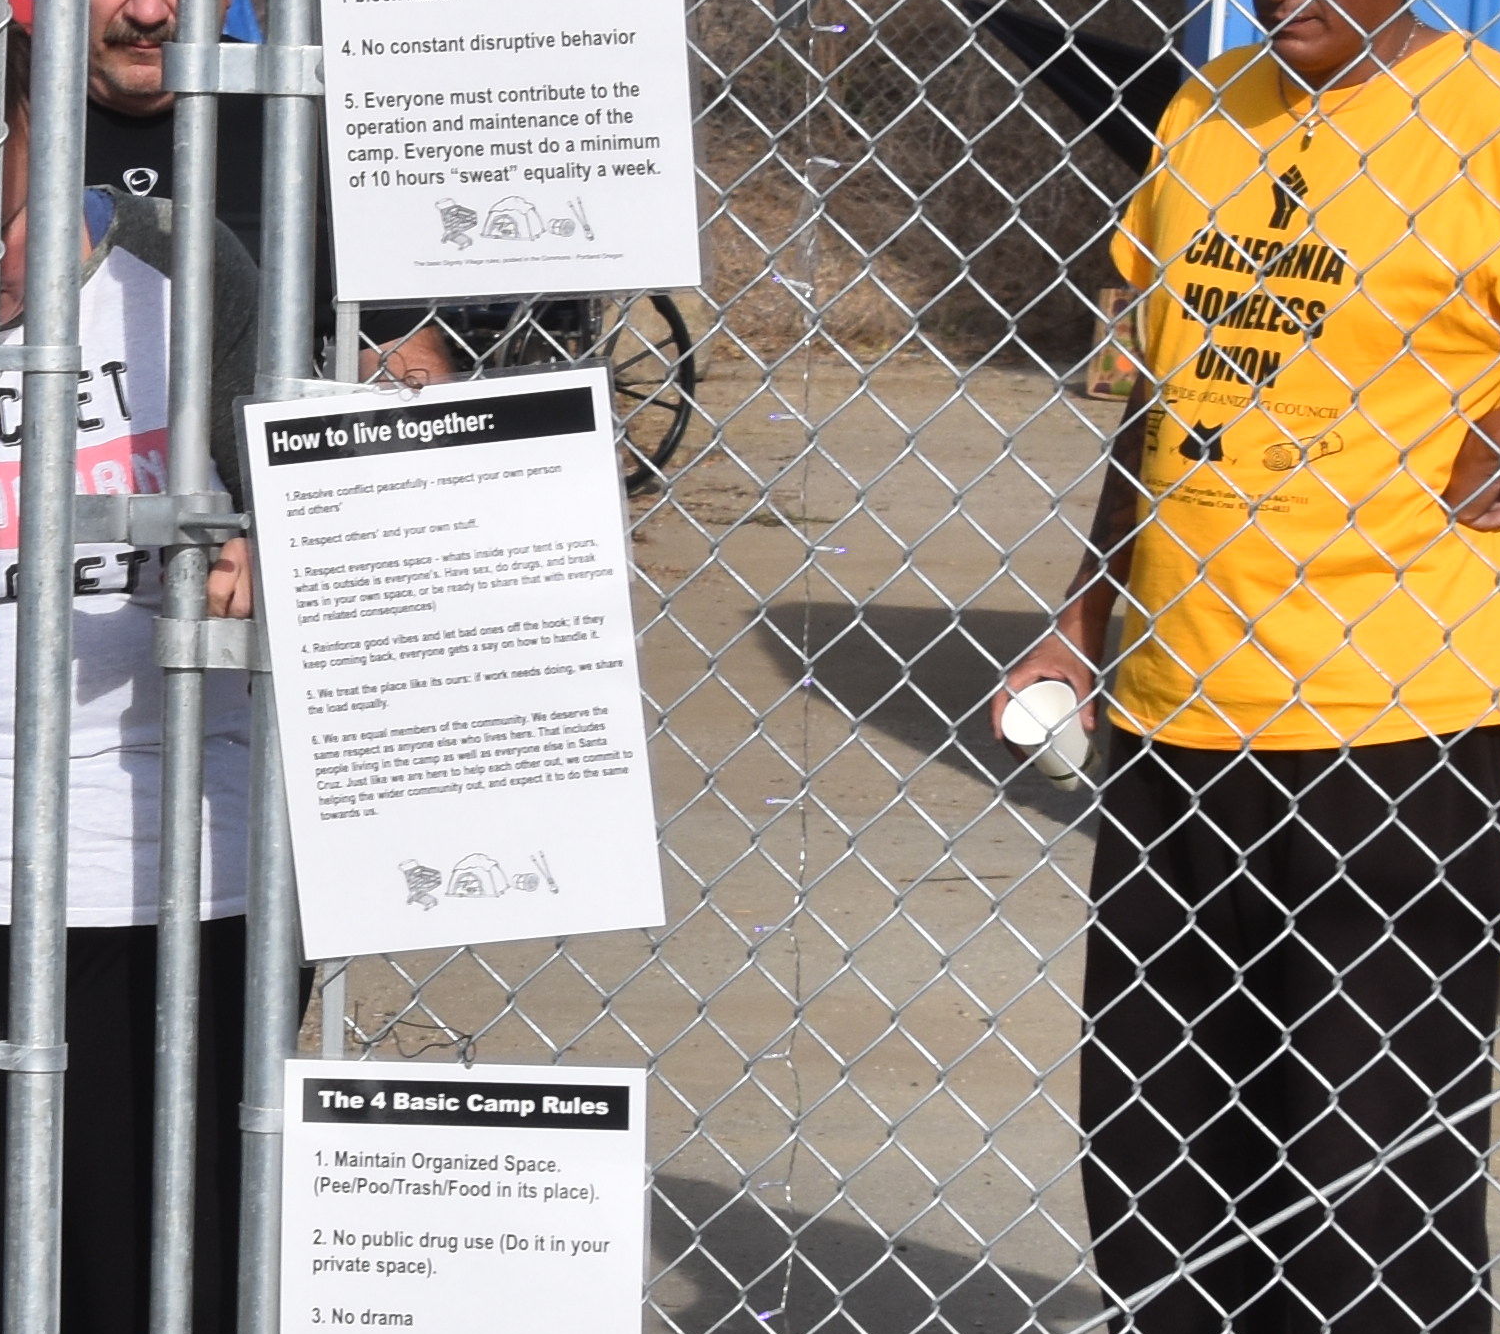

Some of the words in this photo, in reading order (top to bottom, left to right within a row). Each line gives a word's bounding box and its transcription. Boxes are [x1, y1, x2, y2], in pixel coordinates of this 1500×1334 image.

[341, 39, 356, 57] 4.
[361, 38, 385, 56] No
[390, 36, 465, 55] constant
[470, 32, 556, 54] disruptive
[561, 28, 637, 48] behavior
[344, 92, 359, 110] 5.
[364, 91, 445, 112] Everyone
[449, 87, 493, 105] must
[497, 84, 586, 103] contribute
[590, 83, 608, 99] to
[612, 81, 640, 98] the
[345, 117, 427, 140] operation
[432, 114, 464, 132] and
[469, 113, 580, 131] maintenance
[584, 108, 602, 126] of
[606, 107, 634, 125] the
[347, 147, 399, 165] camp.
[404, 142, 485, 163] Everyone
[490, 138, 534, 156] must
[537, 137, 560, 154] do
[565, 139, 575, 153] a
[580, 134, 660, 152] minimum
[349, 170, 366, 188] of
[371, 170, 391, 187] 10
[395, 169, 445, 186] hours
[523, 161, 592, 184] equality
[597, 164, 607, 178] a
[611, 158, 661, 177] week.
[1185, 228, 1348, 286] CALIFORNIA
[1181, 282, 1327, 340] HOMELESS
[1194, 344, 1282, 389] UNION
[272, 430, 321, 453] How
[324, 426, 349, 447] to
[353, 421, 392, 445] live
[395, 412, 495, 443] together:
[317, 1090, 365, 1109] The
[370, 1091, 387, 1110] 4
[393, 1092, 460, 1111] Basic
[466, 1093, 536, 1117] Camp
[542, 1096, 609, 1115] Rules
[315, 1150, 328, 1167] 1.
[334, 1150, 406, 1169] Maintain
[411, 1152, 499, 1174] Organized
[504, 1154, 561, 1176] Space.
[314, 1176, 491, 1197] (Pee/Poo/Trash/Food
[497, 1181, 512, 1198] in
[517, 1182, 538, 1199] its
[543, 1182, 599, 1204] place).
[312, 1228, 327, 1245] 2.
[333, 1229, 356, 1246] No
[361, 1230, 414, 1251] public
[419, 1231, 458, 1254] drug
[464, 1237, 494, 1250] use
[499, 1233, 529, 1254] (Do
[534, 1234, 545, 1252] it
[550, 1235, 565, 1252] in
[571, 1240, 610, 1257] your
[312, 1255, 371, 1275] private
[376, 1258, 437, 1278] space).
[312, 1307, 326, 1324] 3.
[331, 1308, 355, 1325] No
[360, 1308, 414, 1327] drama
